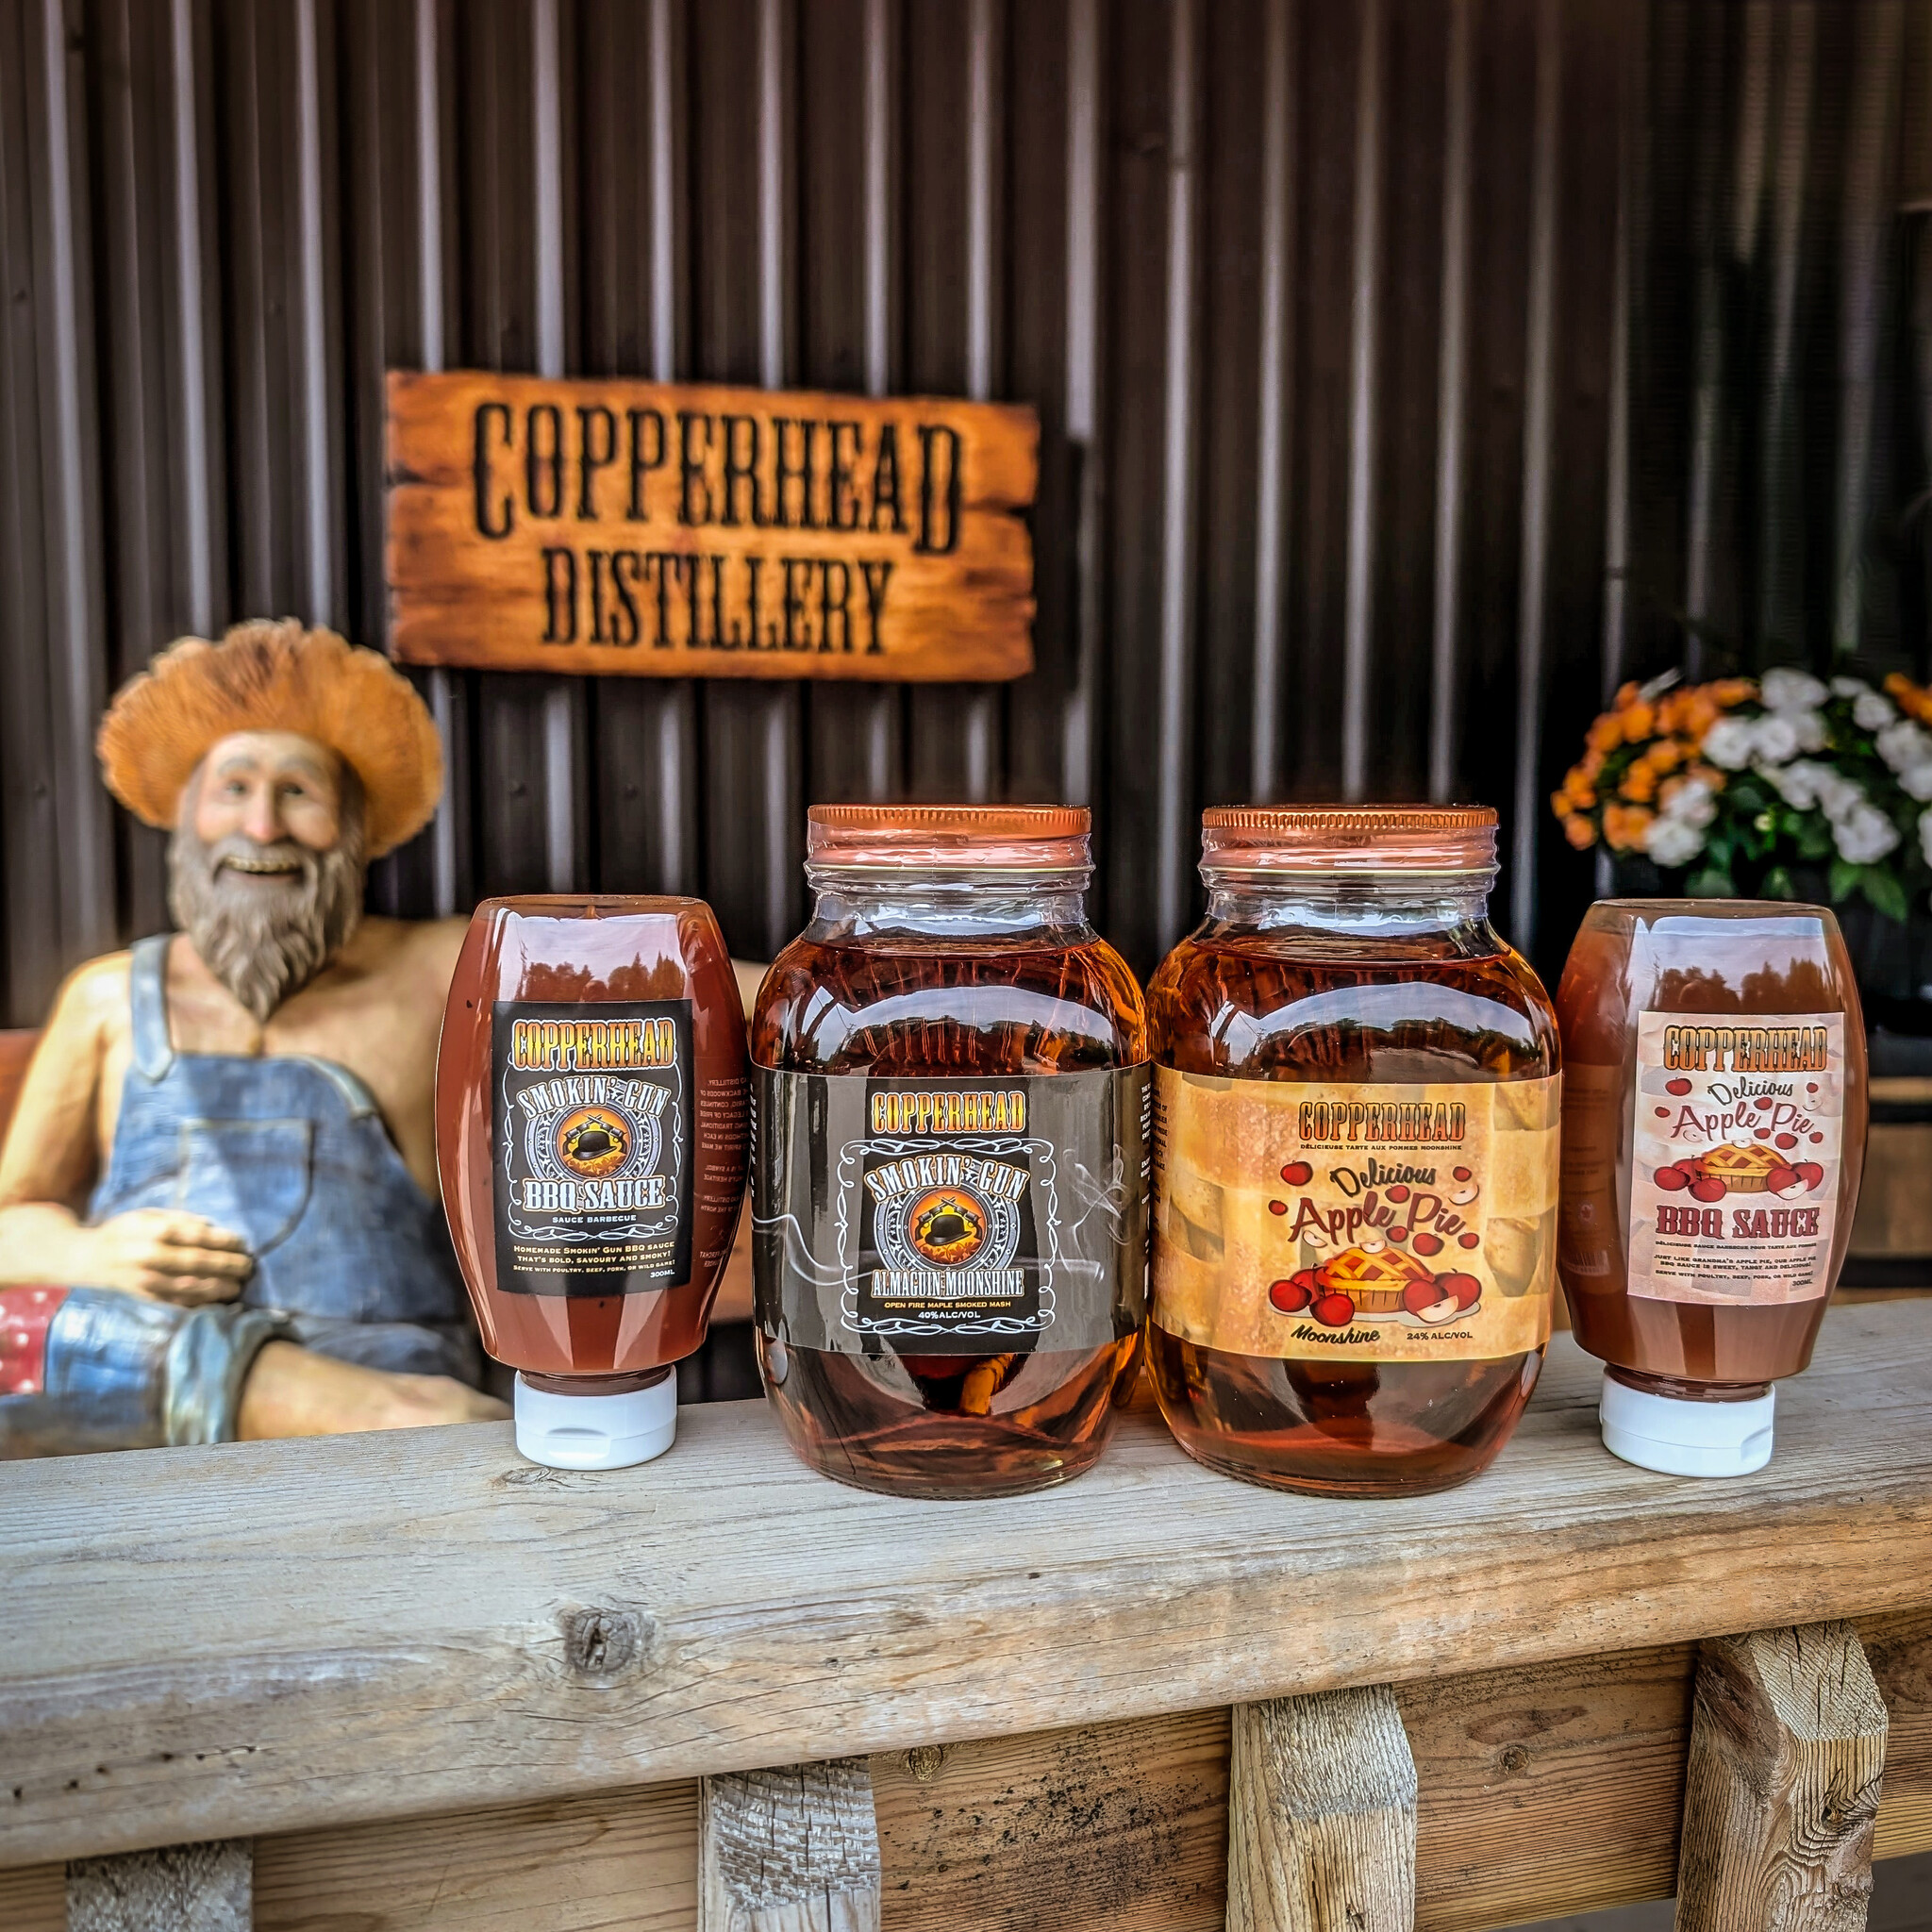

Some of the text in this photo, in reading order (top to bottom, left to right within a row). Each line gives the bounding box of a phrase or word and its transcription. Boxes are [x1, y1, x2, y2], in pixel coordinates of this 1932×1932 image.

[473, 402, 963, 556] COPPERHEAD
[541, 545, 896, 656] DISTILLERY
[512, 1018, 677, 1072] COPPERHEAD
[1663, 1024, 1827, 1073] COPPERHEAD
[517, 1075, 672, 1120] SMOKIN' GUN
[1707, 1075, 1794, 1106] Delicious
[871, 1091, 1026, 1134] COPPERHEAD
[1298, 1101, 1465, 1141] COPPERHEAD
[1670, 1101, 1814, 1141] Apple Pie
[523, 1175, 666, 1214] BBQ SAUCE
[863, 1155, 1031, 1203] SMOKIN' GUN
[1329, 1158, 1437, 1197] Delicious
[587, 1214, 637, 1224] BARBECUE
[1288, 1191, 1467, 1245] Apple Pie
[1656, 1205, 1820, 1240] BBQ SAUCE
[517, 1255, 547, 1263] THAT'S
[640, 1250, 671, 1260] SMOKY!
[625, 1244, 645, 1253] BBQ
[647, 1241, 675, 1249] SAUCE
[649, 1269, 675, 1278] 300ML
[871, 1268, 1024, 1298] ALMAGUIN MOONSHINE
[1291, 1324, 1381, 1344] Moonshine
[1407, 1331, 1474, 1341] 24% ALC/VOL
